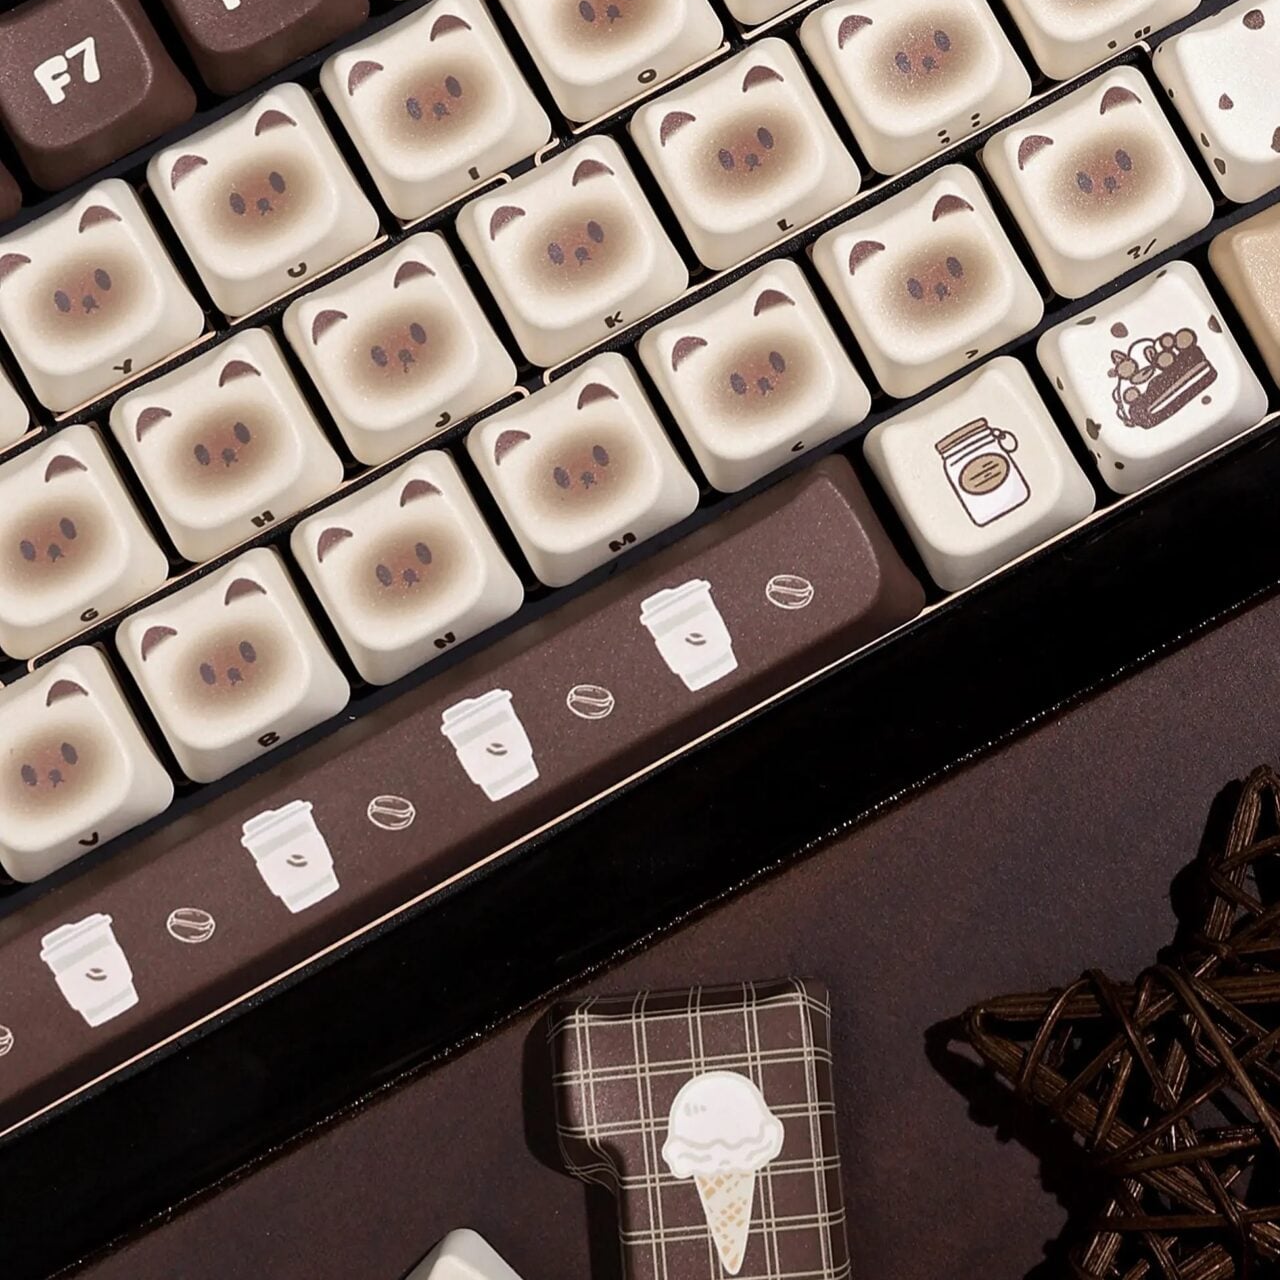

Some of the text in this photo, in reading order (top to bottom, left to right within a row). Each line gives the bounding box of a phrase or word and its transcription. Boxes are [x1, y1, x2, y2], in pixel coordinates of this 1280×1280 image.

[33, 36, 101, 105] F7
[637, 68, 657, 84] O
[776, 218, 794, 232] L
[287, 262, 307, 278] U
[604, 310, 624, 329] K
[113, 358, 133, 375] Y
[434, 411, 452, 428] J
[250, 510, 275, 528] H
[608, 532, 637, 553] M
[80, 607, 99, 622] G
[433, 631, 457, 650] N
[257, 731, 281, 748] B
[78, 831, 99, 847] V
